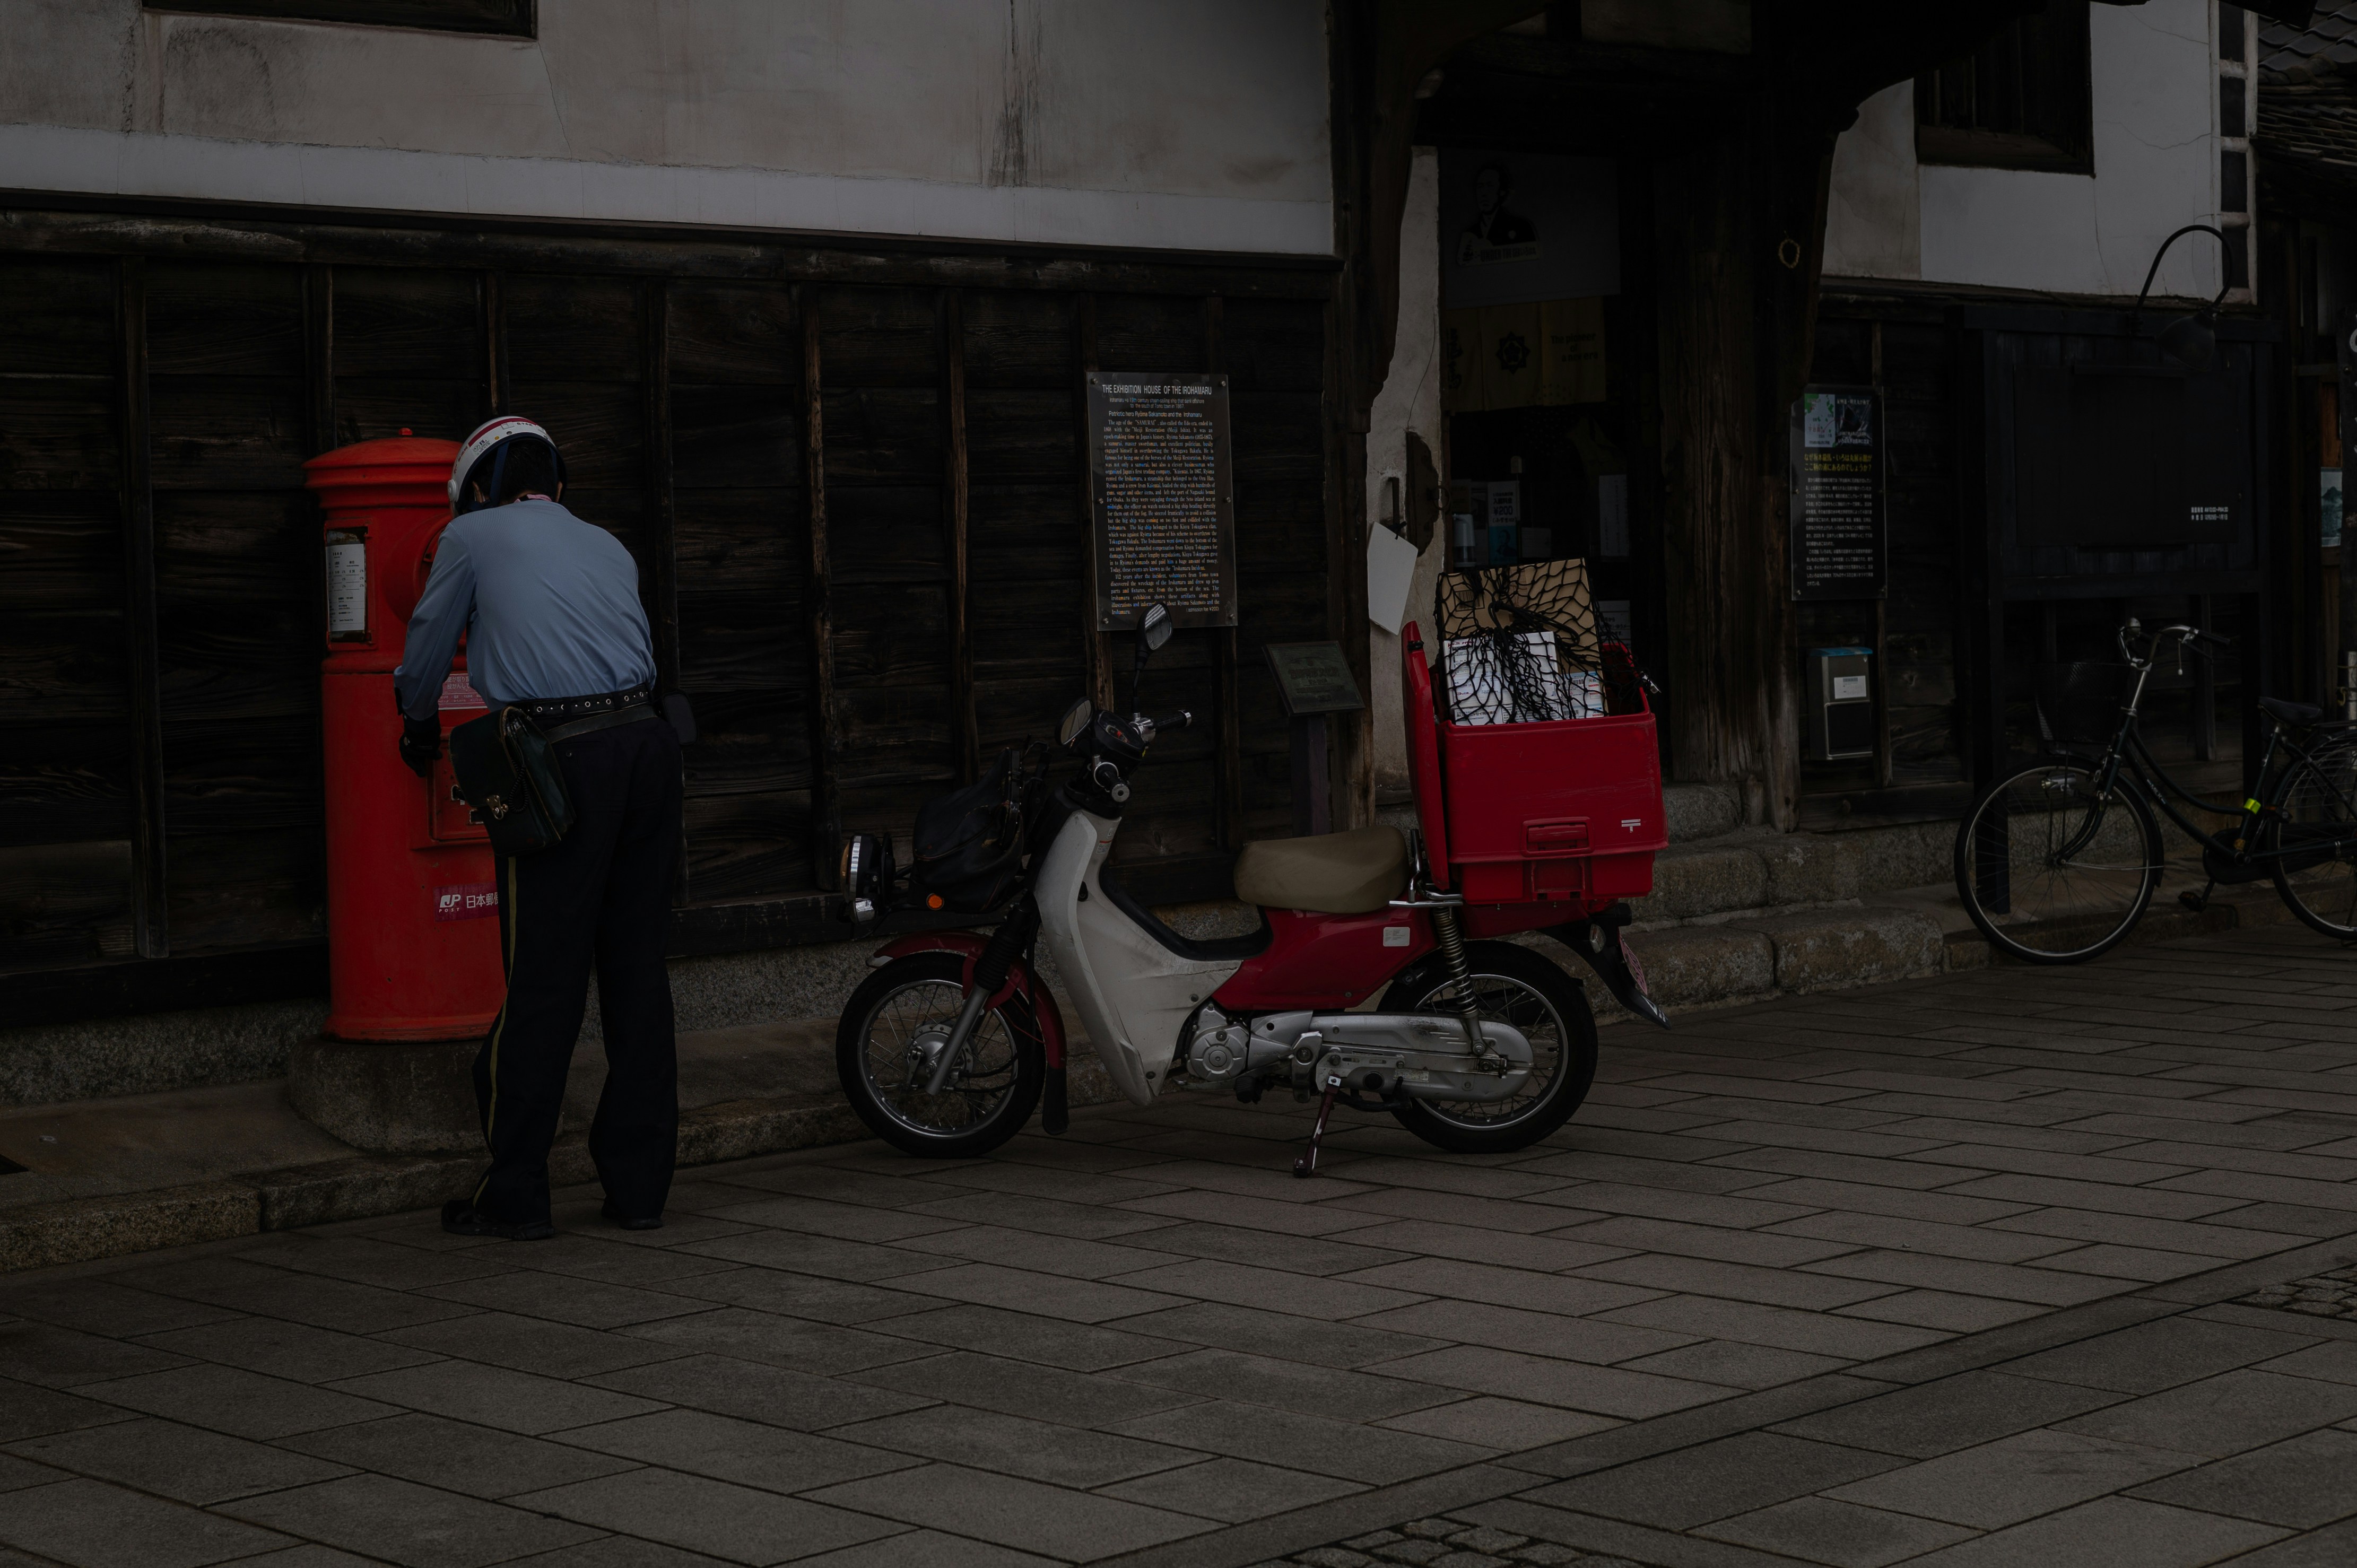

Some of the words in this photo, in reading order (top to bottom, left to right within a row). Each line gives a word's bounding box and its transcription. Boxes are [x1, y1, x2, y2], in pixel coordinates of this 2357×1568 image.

[1551, 335, 1564, 344] The
[1566, 333, 1596, 344] pioneer
[1102, 384, 1112, 393] THE
[1113, 384, 1141, 393] EXHIBITION
[1143, 385, 1161, 393] HOUSE
[1163, 385, 1170, 394] OF
[1171, 385, 1181, 394] THE
[1182, 386, 1212, 394] IROHAMARU
[1494, 506, 1513, 515] ¥200
[439, 894, 462, 908] JP
